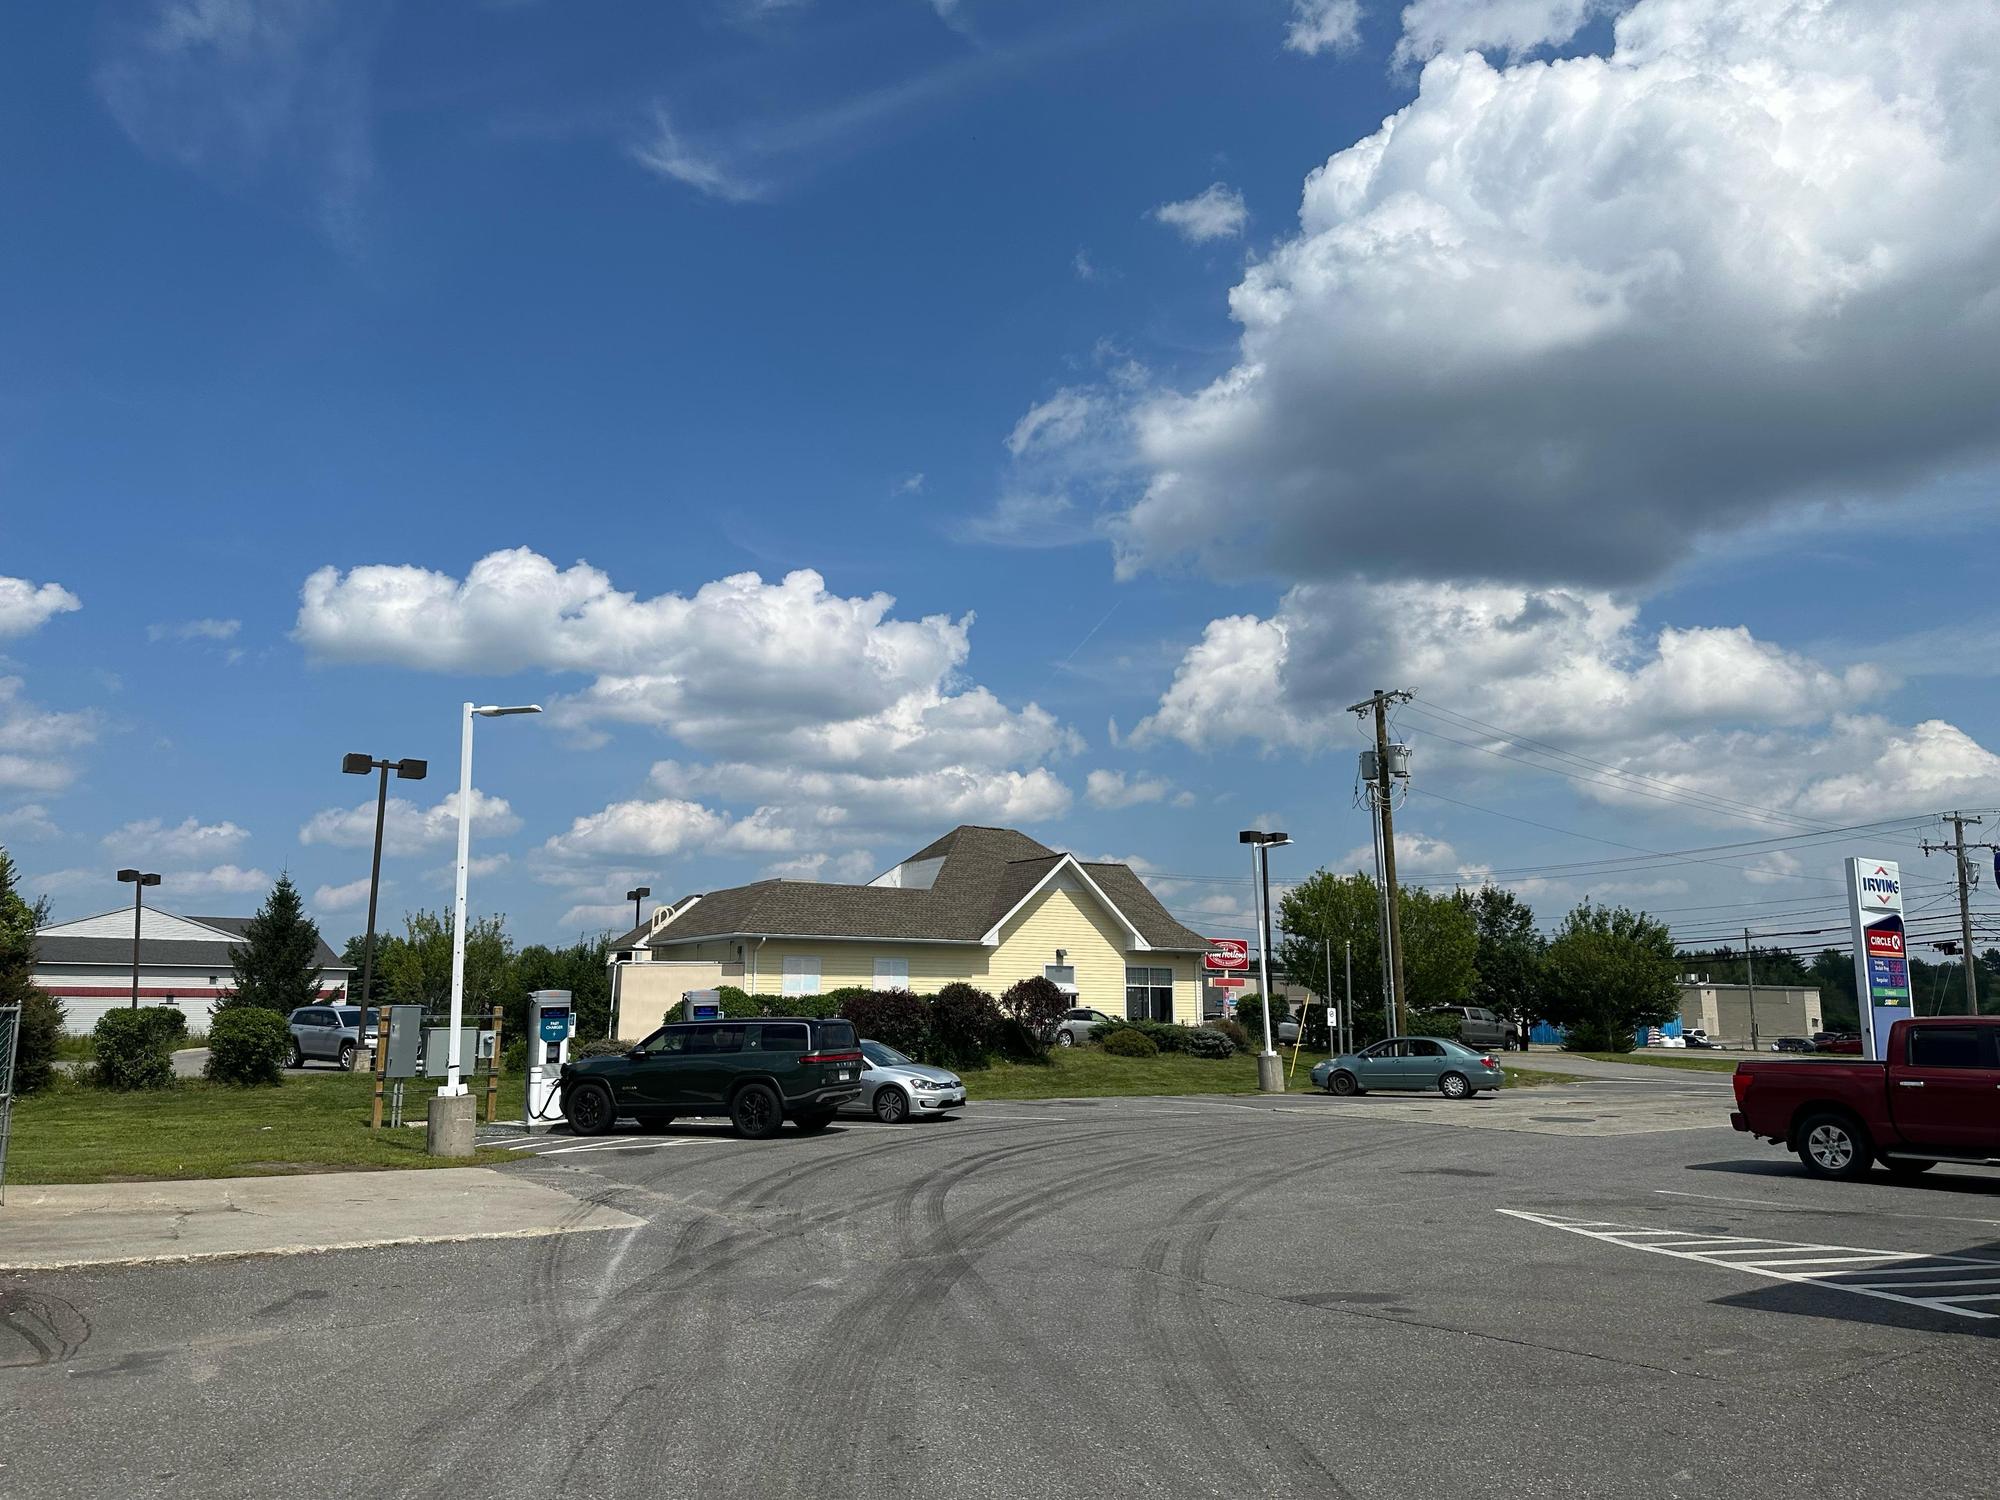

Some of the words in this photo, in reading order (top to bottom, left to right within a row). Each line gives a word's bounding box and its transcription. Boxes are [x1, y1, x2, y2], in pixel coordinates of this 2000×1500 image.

[1862, 877, 1899, 894] IRVING
[1870, 936, 1892, 946] CIRCLE
[1892, 936, 1900, 948] K
